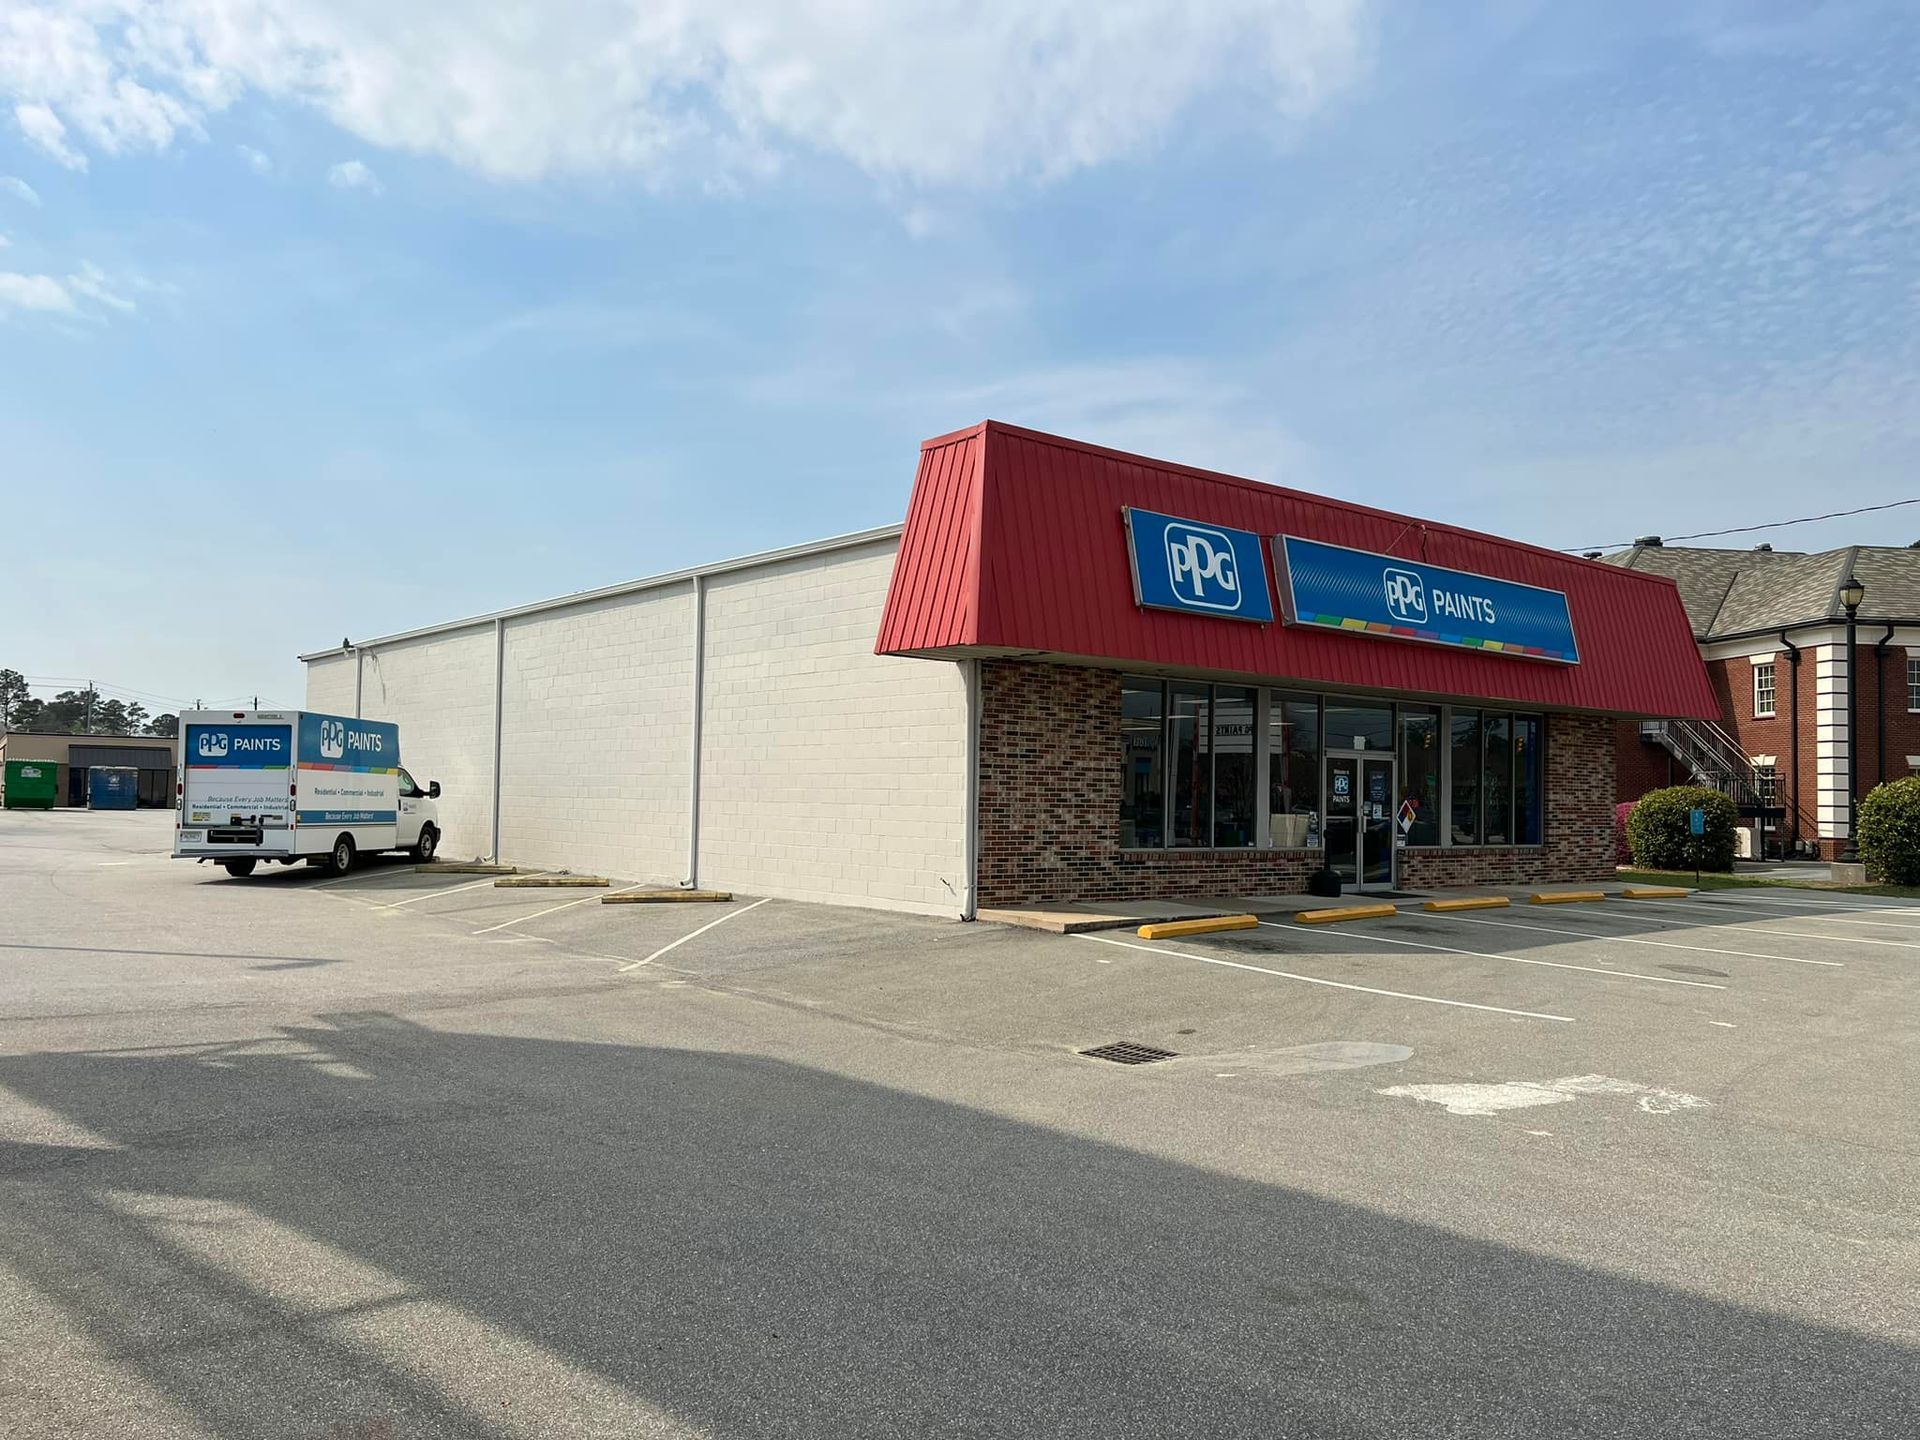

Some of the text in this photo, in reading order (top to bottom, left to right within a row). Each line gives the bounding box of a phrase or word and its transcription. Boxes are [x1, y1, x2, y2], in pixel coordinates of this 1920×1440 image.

[1170, 535, 1237, 597] PPG
[1387, 576, 1496, 624] PPG PAINTS
[200, 732, 281, 752] PPG PAINTS
[322, 721, 382, 752] PPG PAINTS
[314, 787, 337, 796] Residential
[341, 788, 363, 796] Commercial
[1333, 795, 1350, 803] PAINTS
